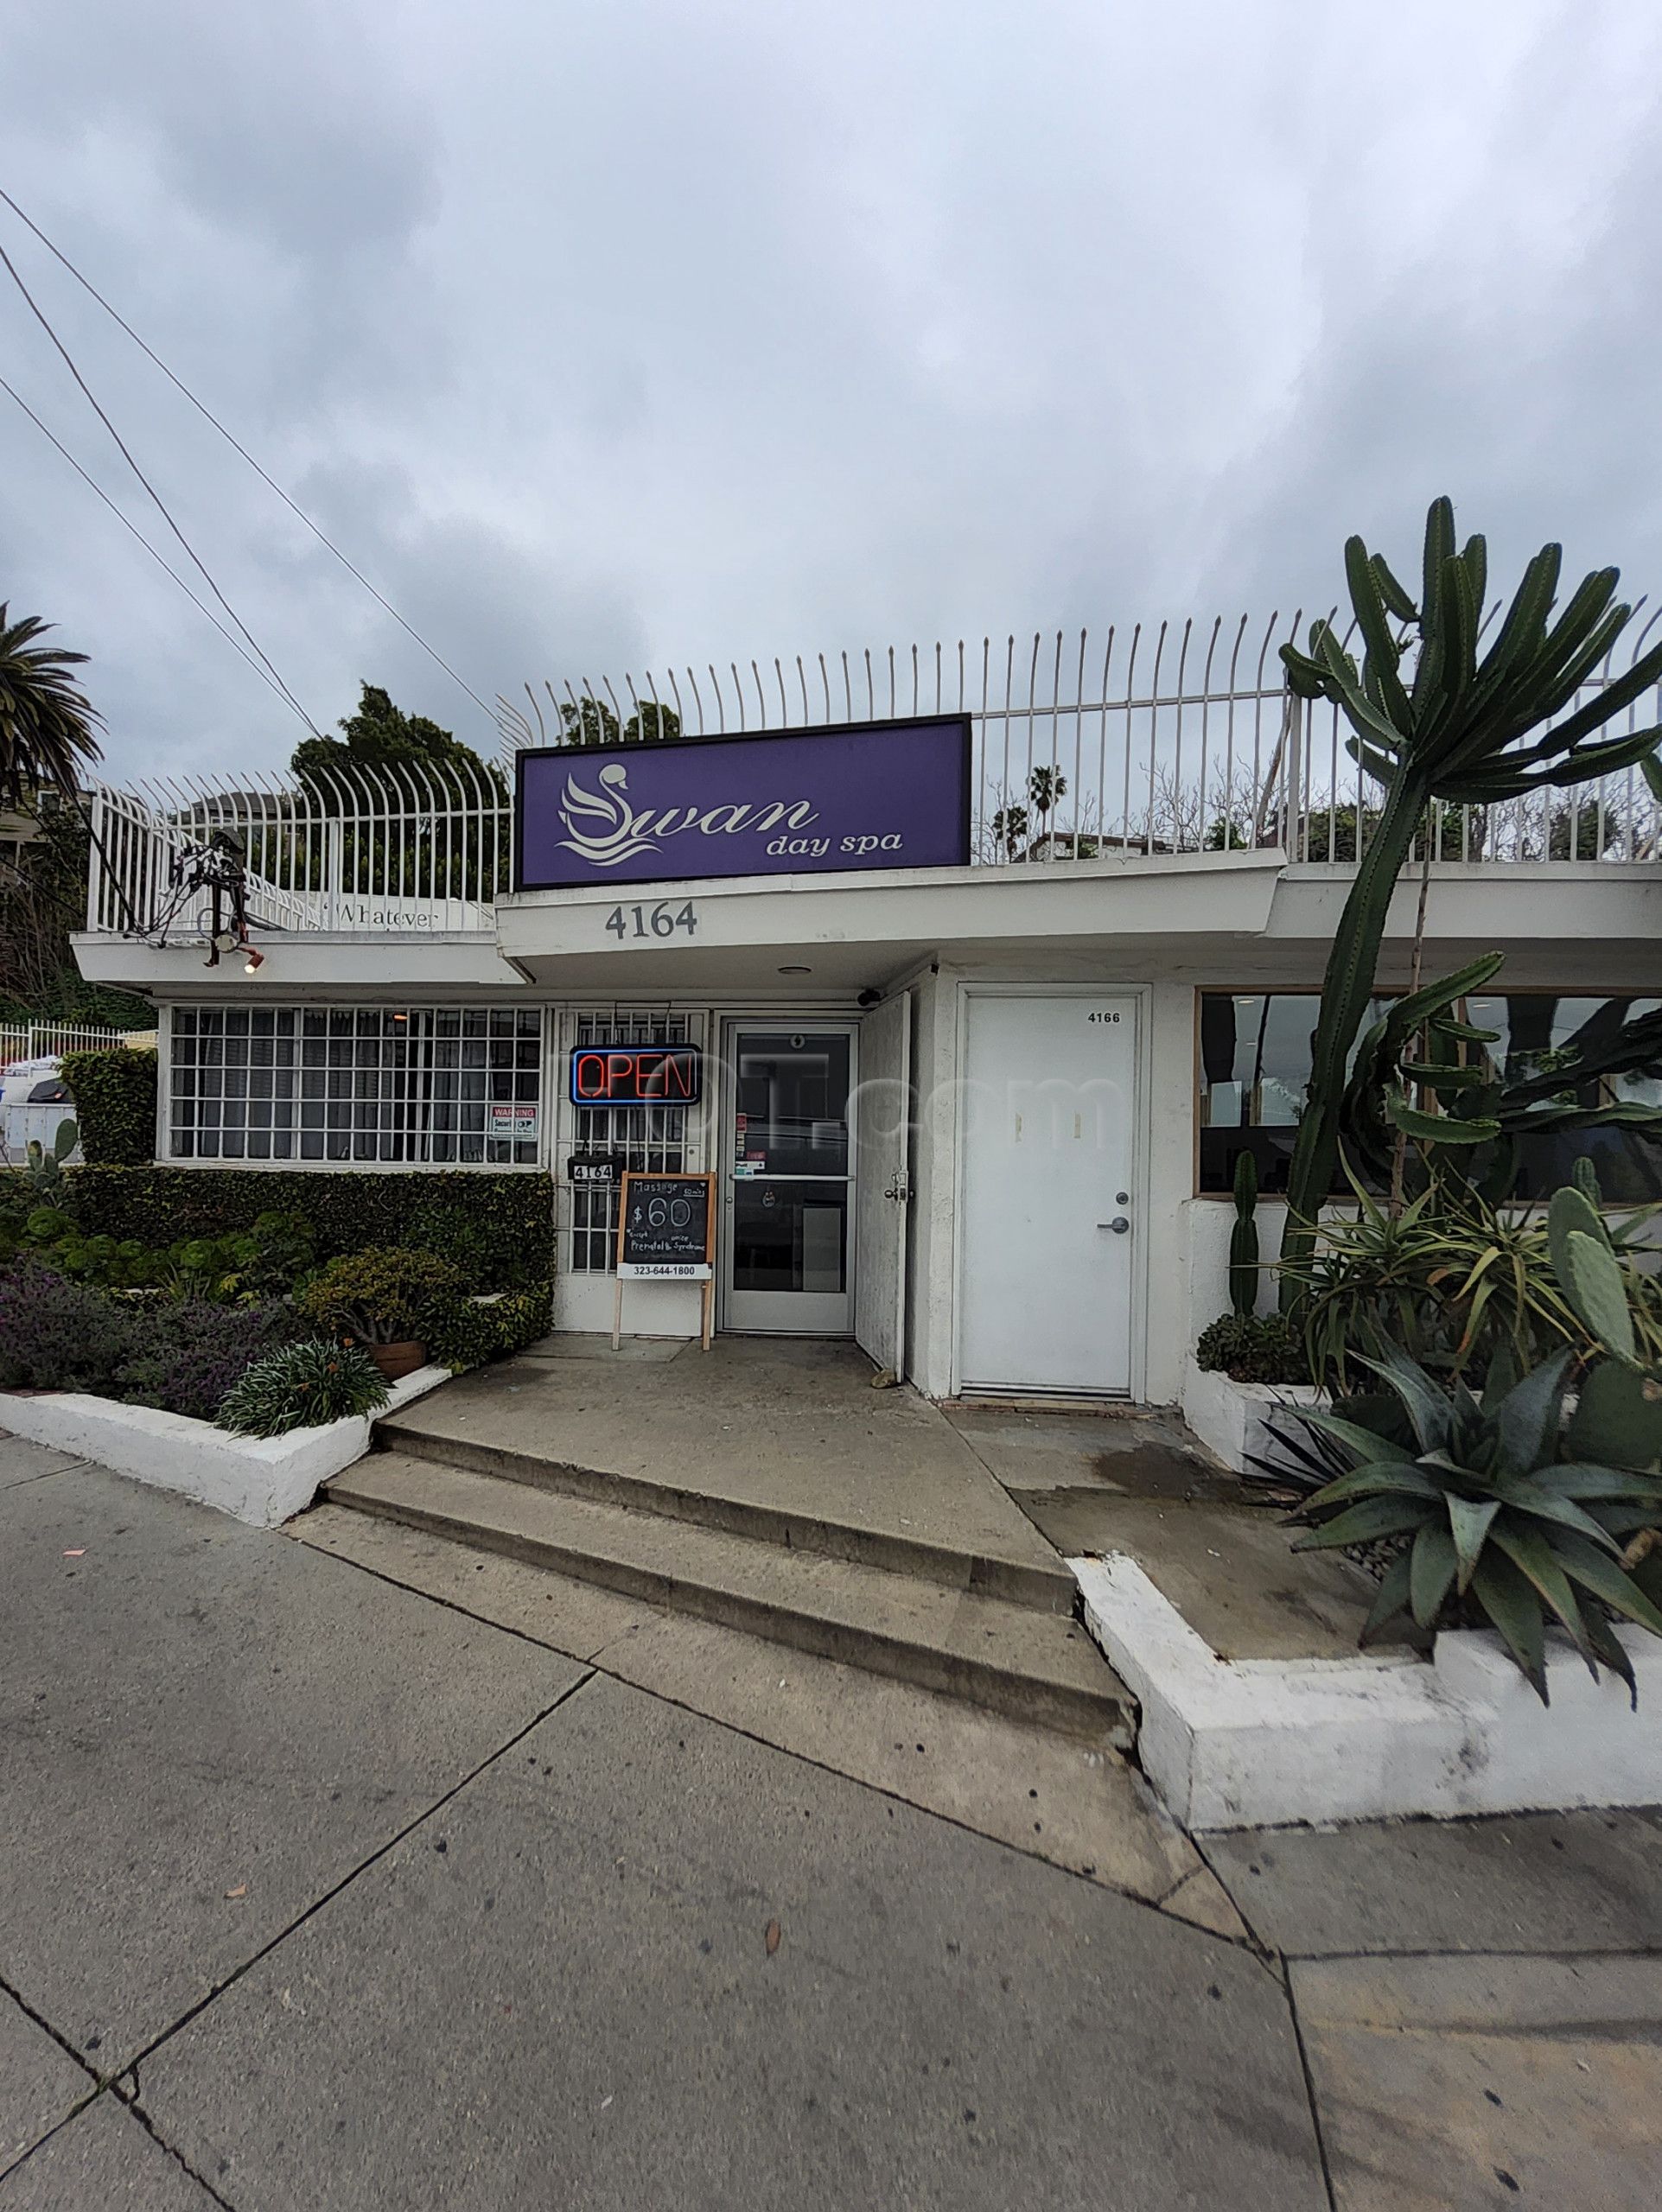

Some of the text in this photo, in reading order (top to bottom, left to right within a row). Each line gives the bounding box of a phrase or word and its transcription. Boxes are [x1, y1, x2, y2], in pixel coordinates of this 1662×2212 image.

[555, 764, 819, 867] Swan
[766, 831, 903, 858] day spa
[605, 901, 697, 939] 4164
[1087, 1012, 1120, 1023] 4166
[578, 1053, 691, 1097] OPEN
[494, 1108, 534, 1117] WARNING
[575, 1166, 612, 1179] 4164
[634, 1180, 678, 1194] Massage
[634, 1266, 696, 1275] 323-644-1800
